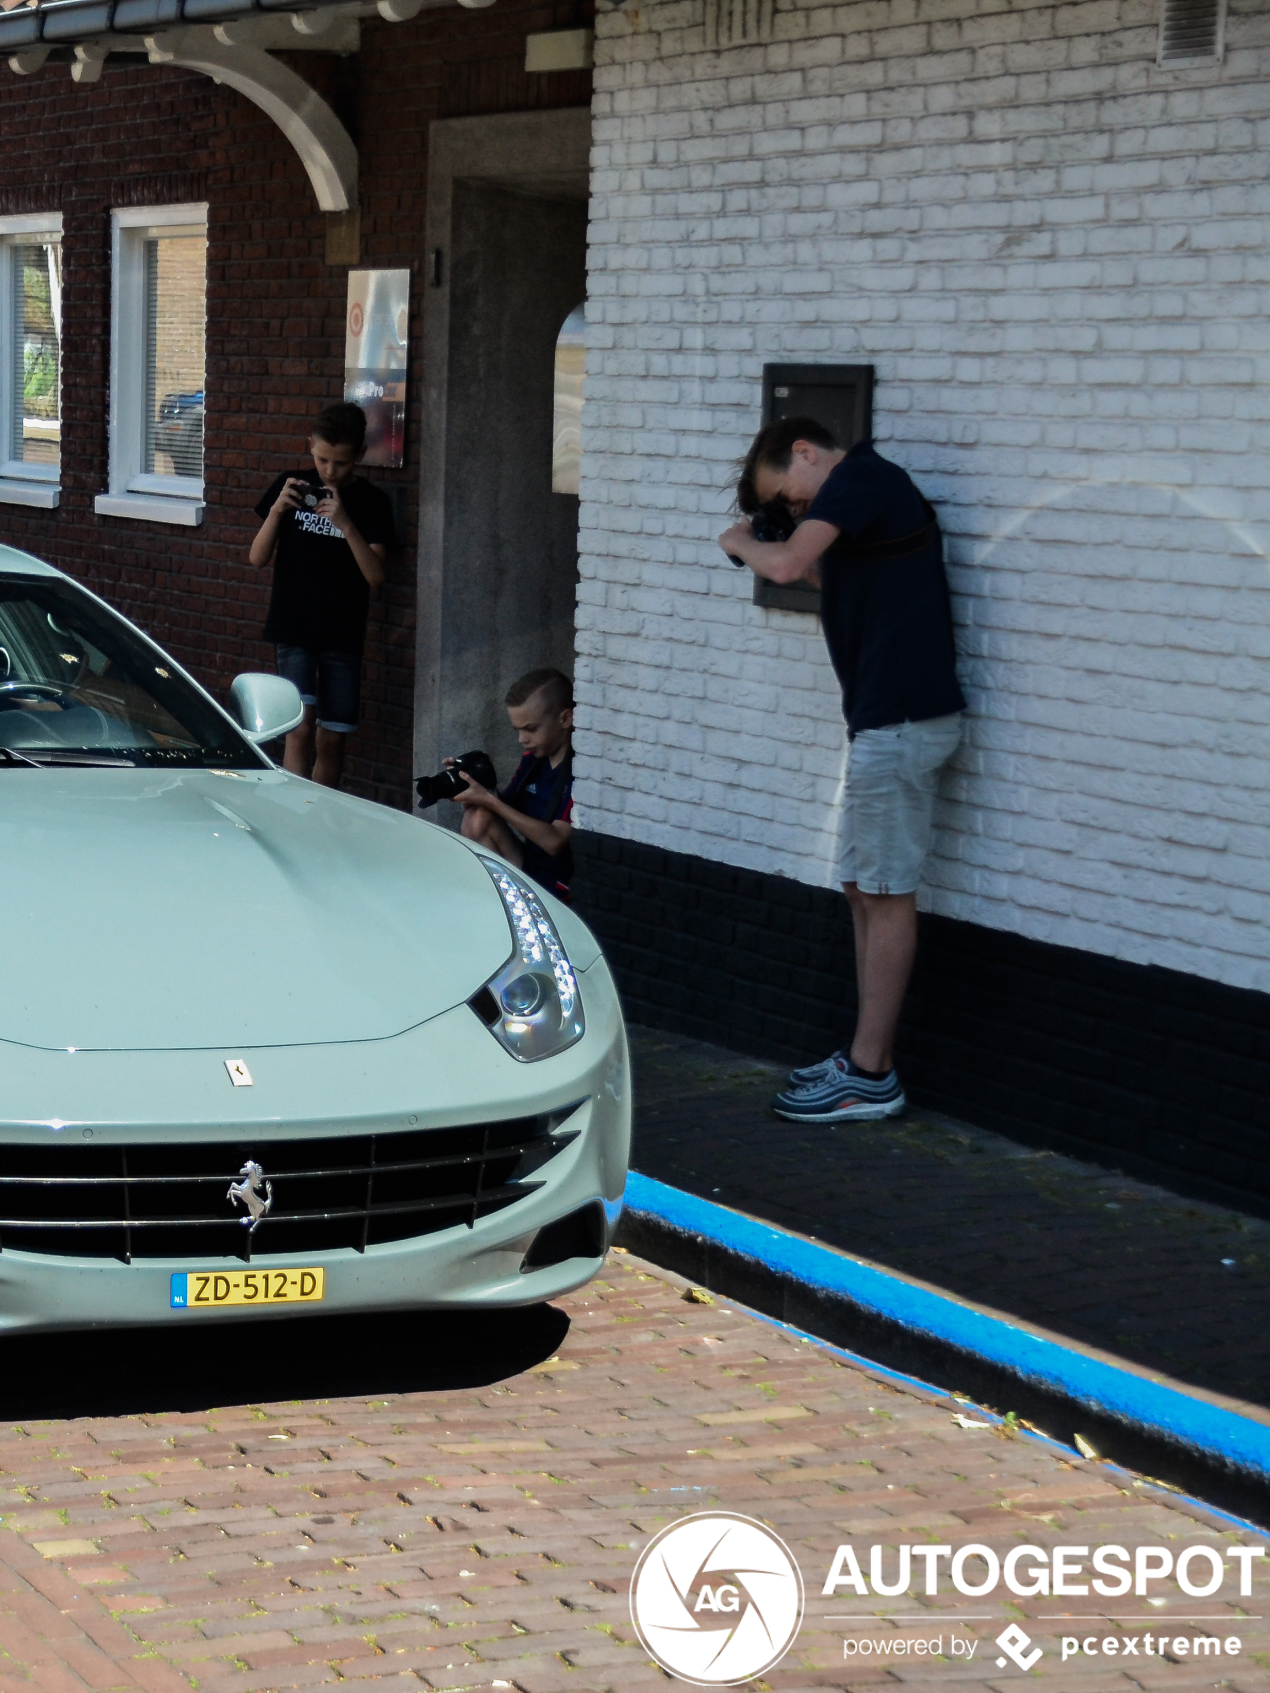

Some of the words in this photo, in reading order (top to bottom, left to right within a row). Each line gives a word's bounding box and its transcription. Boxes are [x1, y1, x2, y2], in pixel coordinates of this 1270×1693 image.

[294, 510, 332, 526] NORTH
[303, 522, 331, 536] FACE
[194, 1271, 317, 1302] ZD-512-D
